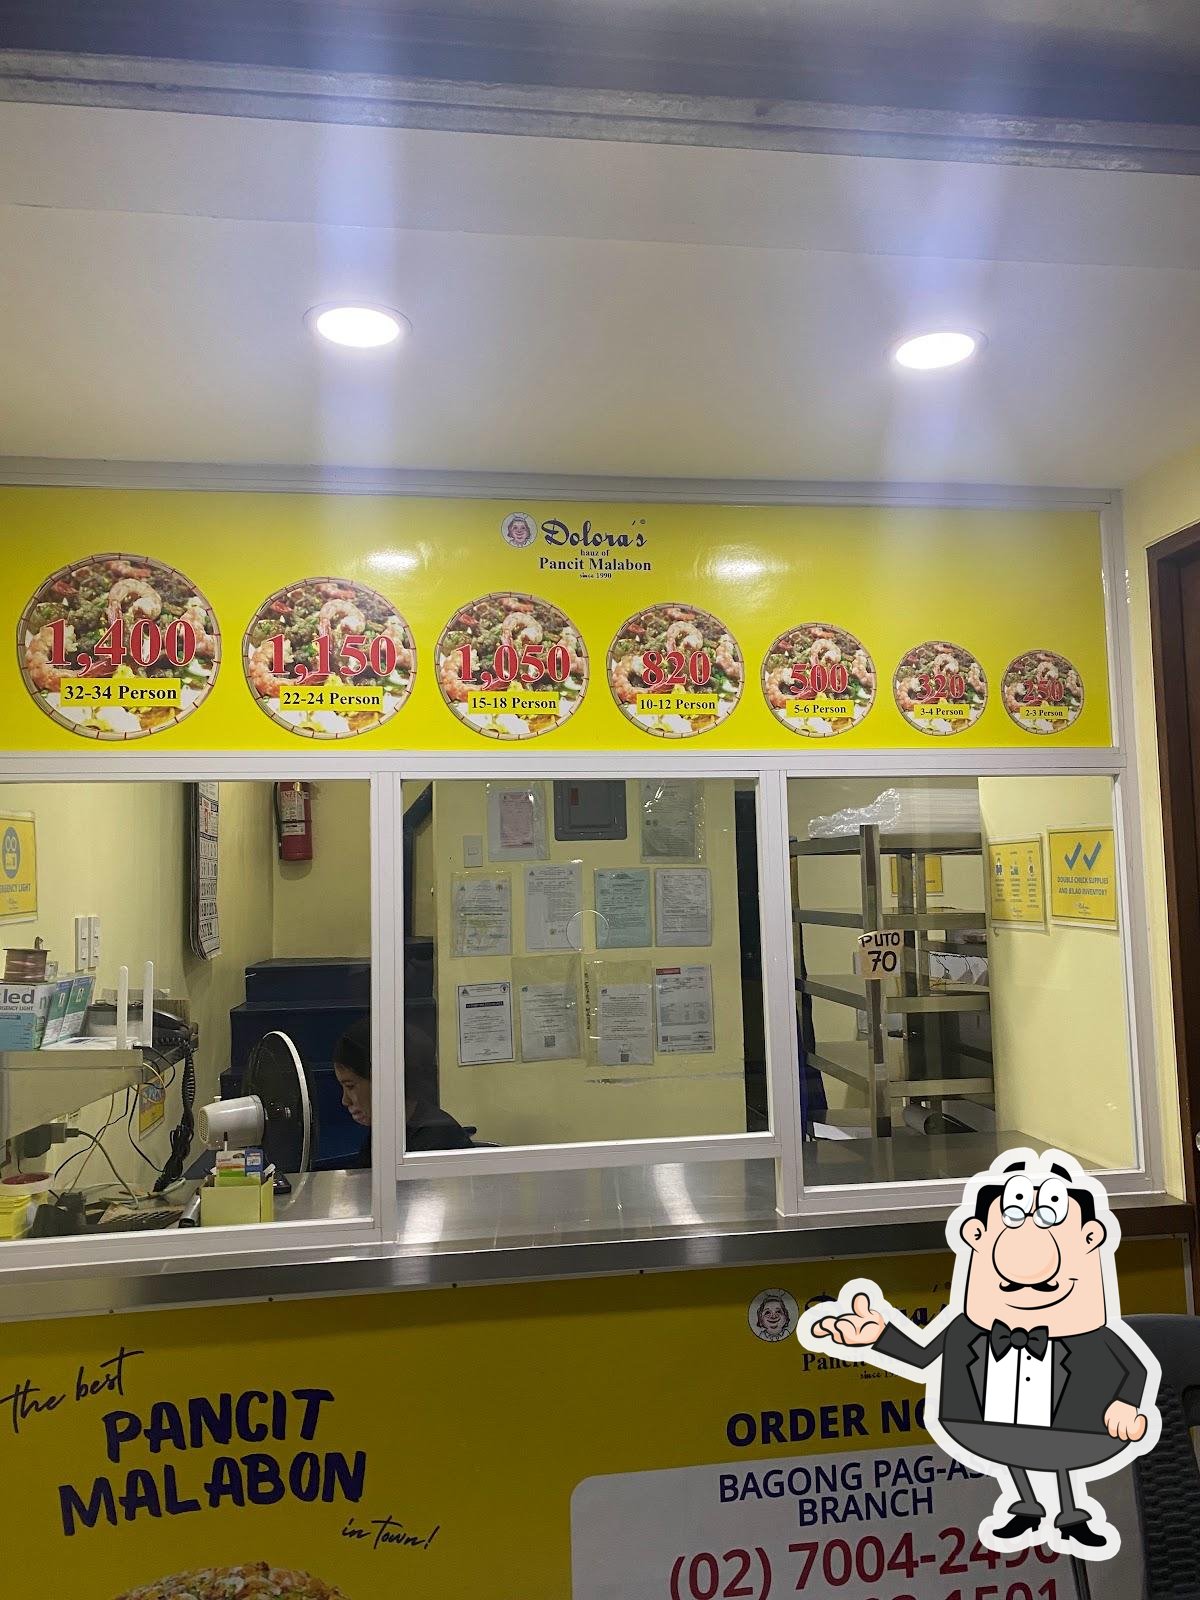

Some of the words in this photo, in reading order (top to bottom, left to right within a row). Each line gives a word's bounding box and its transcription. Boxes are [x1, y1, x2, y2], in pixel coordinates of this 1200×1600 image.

[541, 518, 647, 547] Dolora's
[539, 557, 584, 570] Pancit
[589, 558, 651, 571] Malabon
[45, 618, 197, 678] 1,400
[266, 634, 396, 684] 1,150
[455, 643, 571, 688] 1,050
[641, 650, 711, 687] 820
[790, 663, 849, 694] 500
[64, 686, 113, 702] 32-34
[118, 685, 177, 702] Person
[283, 692, 325, 706] 22-24
[330, 692, 380, 707] Person
[917, 675, 965, 701] 320
[1022, 680, 1063, 703] 250
[471, 697, 508, 710] 15-18
[512, 697, 557, 710] Person
[640, 699, 672, 711] 10-12
[675, 698, 716, 711] Person
[794, 704, 809, 714] 5-6
[812, 703, 847, 715] Person
[920, 708, 934, 717] 3-4
[937, 708, 964, 717] Person
[1024, 709, 1037, 717] 2-3
[1038, 709, 1063, 717] Person
[860, 932, 900, 948] PUTO
[867, 950, 897, 972] 70
[3, 989, 35, 1004] led
[0, 1380, 65, 1433] the
[76, 1346, 144, 1402] best
[101, 1389, 335, 1464] PANCIT
[727, 1403, 869, 1447] ORDER
[58, 1451, 367, 1537] MALABON
[719, 1462, 863, 1503] BAGONG
[798, 1486, 933, 1527] BRANCH
[342, 1519, 368, 1538] in
[670, 1547, 772, 1600] (02)
